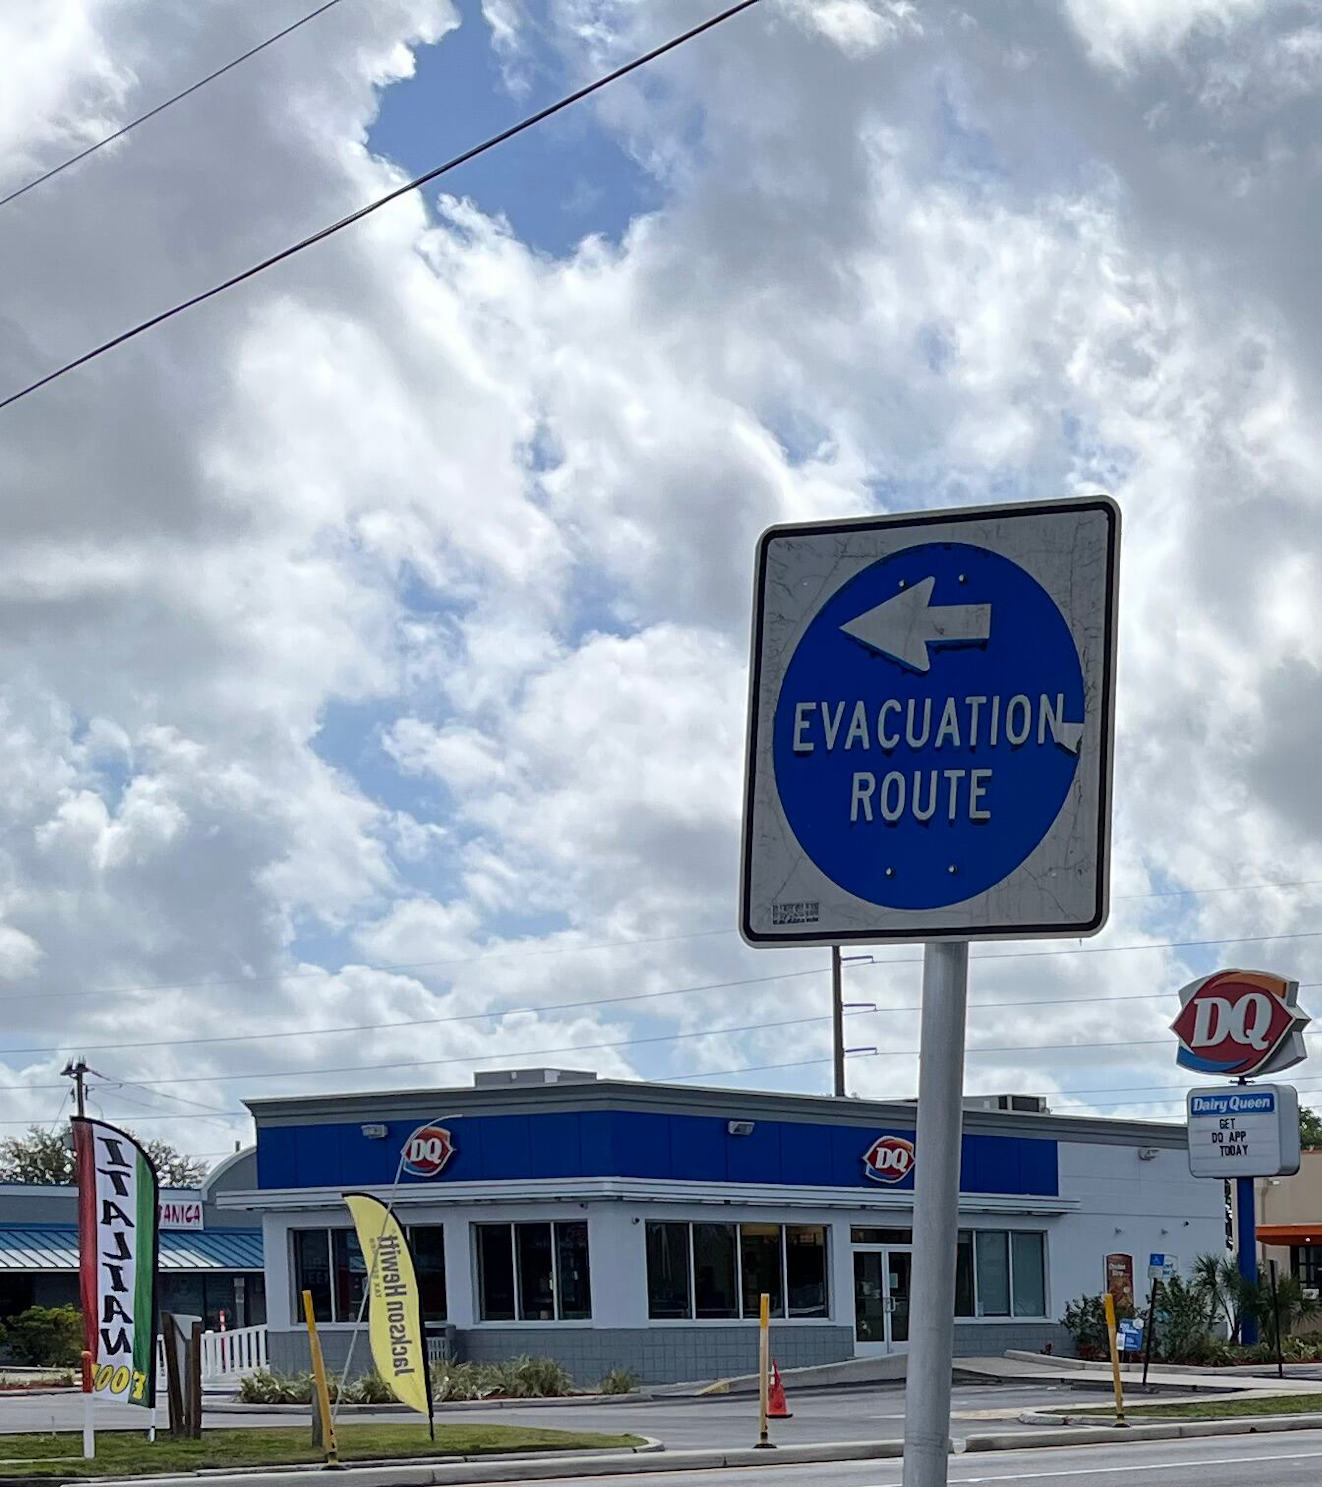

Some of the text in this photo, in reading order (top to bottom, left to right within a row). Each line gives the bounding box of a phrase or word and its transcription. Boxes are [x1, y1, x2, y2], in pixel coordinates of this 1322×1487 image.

[792, 693, 1065, 751] EVACUATION
[849, 769, 993, 822] ROUTE
[1191, 992, 1273, 1050] DQ
[1192, 1096, 1270, 1113] Dairy Queen
[1219, 1118, 1236, 1130] GET
[1229, 1131, 1247, 1143] APP
[410, 1138, 443, 1164] DQ
[875, 1147, 909, 1173] DQ
[1220, 1144, 1248, 1157] TODAY
